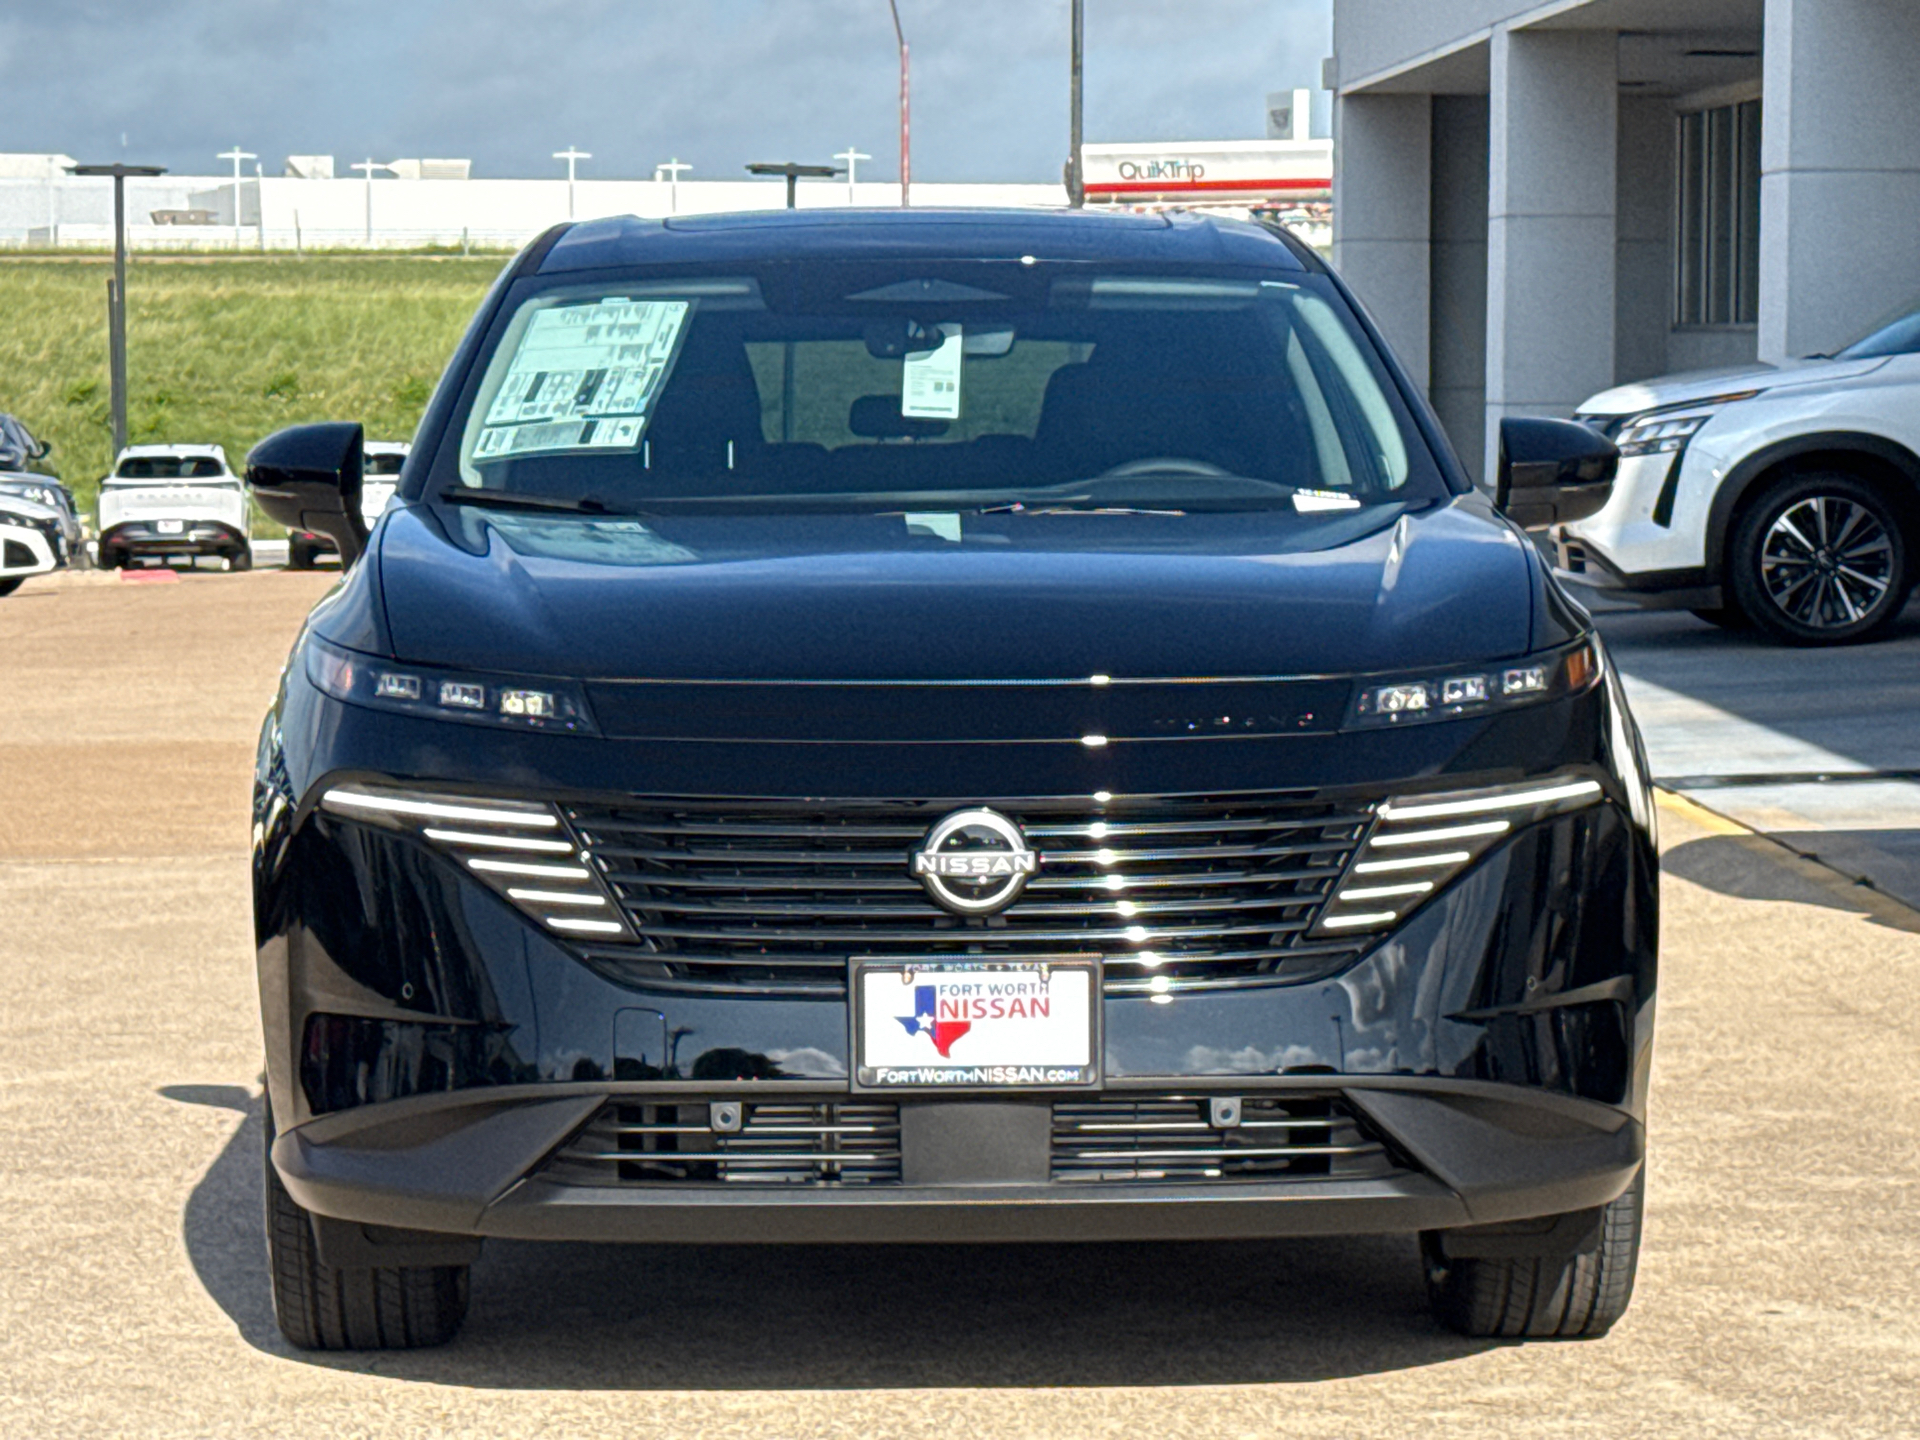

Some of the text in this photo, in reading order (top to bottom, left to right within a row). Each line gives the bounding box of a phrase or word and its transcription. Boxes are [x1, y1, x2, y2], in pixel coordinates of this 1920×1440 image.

[1119, 160, 1205, 183] QuikTrip
[917, 854, 1034, 873] NISSAN
[939, 983, 1050, 996] FORT WORTH
[939, 997, 1050, 1019] NISSAN
